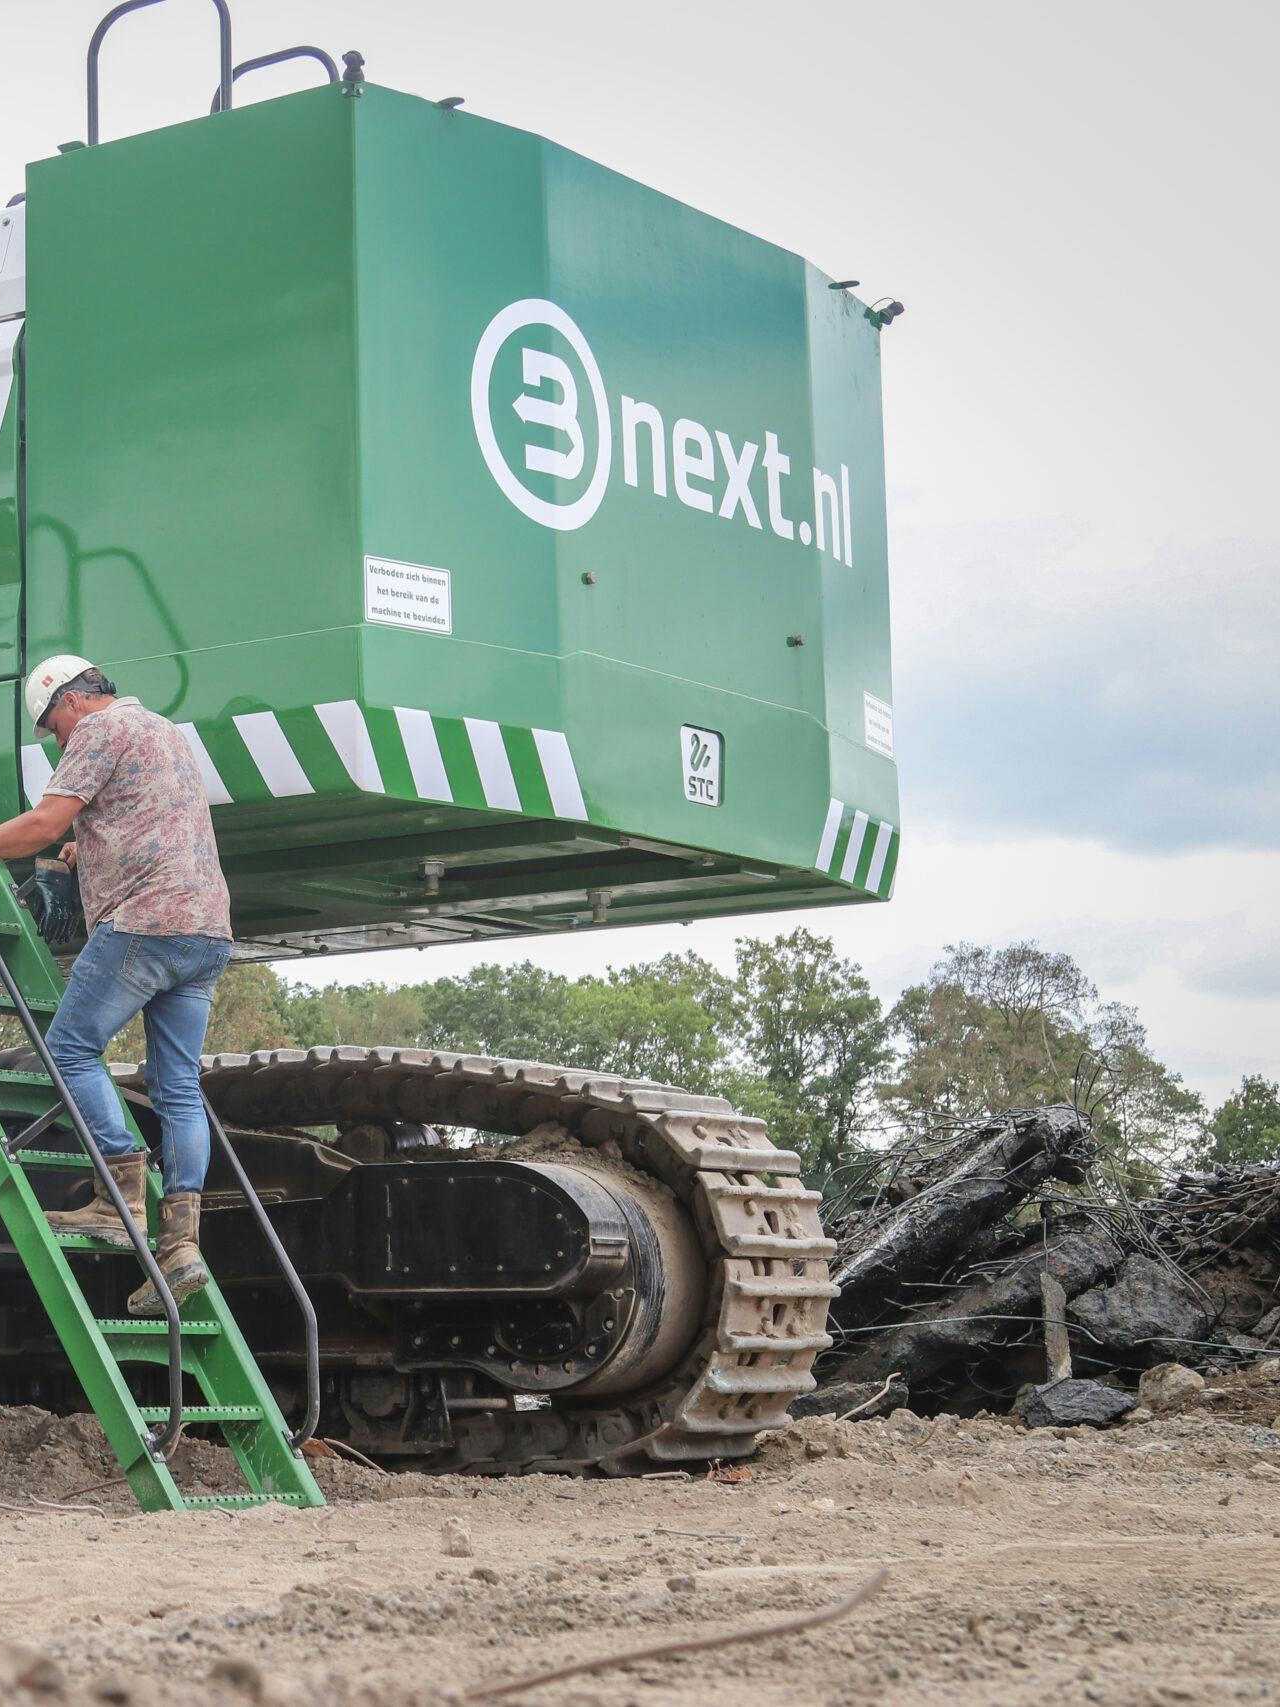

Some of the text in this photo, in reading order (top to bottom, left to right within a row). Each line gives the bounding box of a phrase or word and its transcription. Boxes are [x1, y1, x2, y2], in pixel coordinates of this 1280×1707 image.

[621, 395, 853, 568] next.nl
[369, 565, 446, 586] Verboden zich binnen
[377, 586, 439, 604] het bereik van de
[371, 606, 446, 625] machine te bevinden
[688, 775, 714, 800] STC
